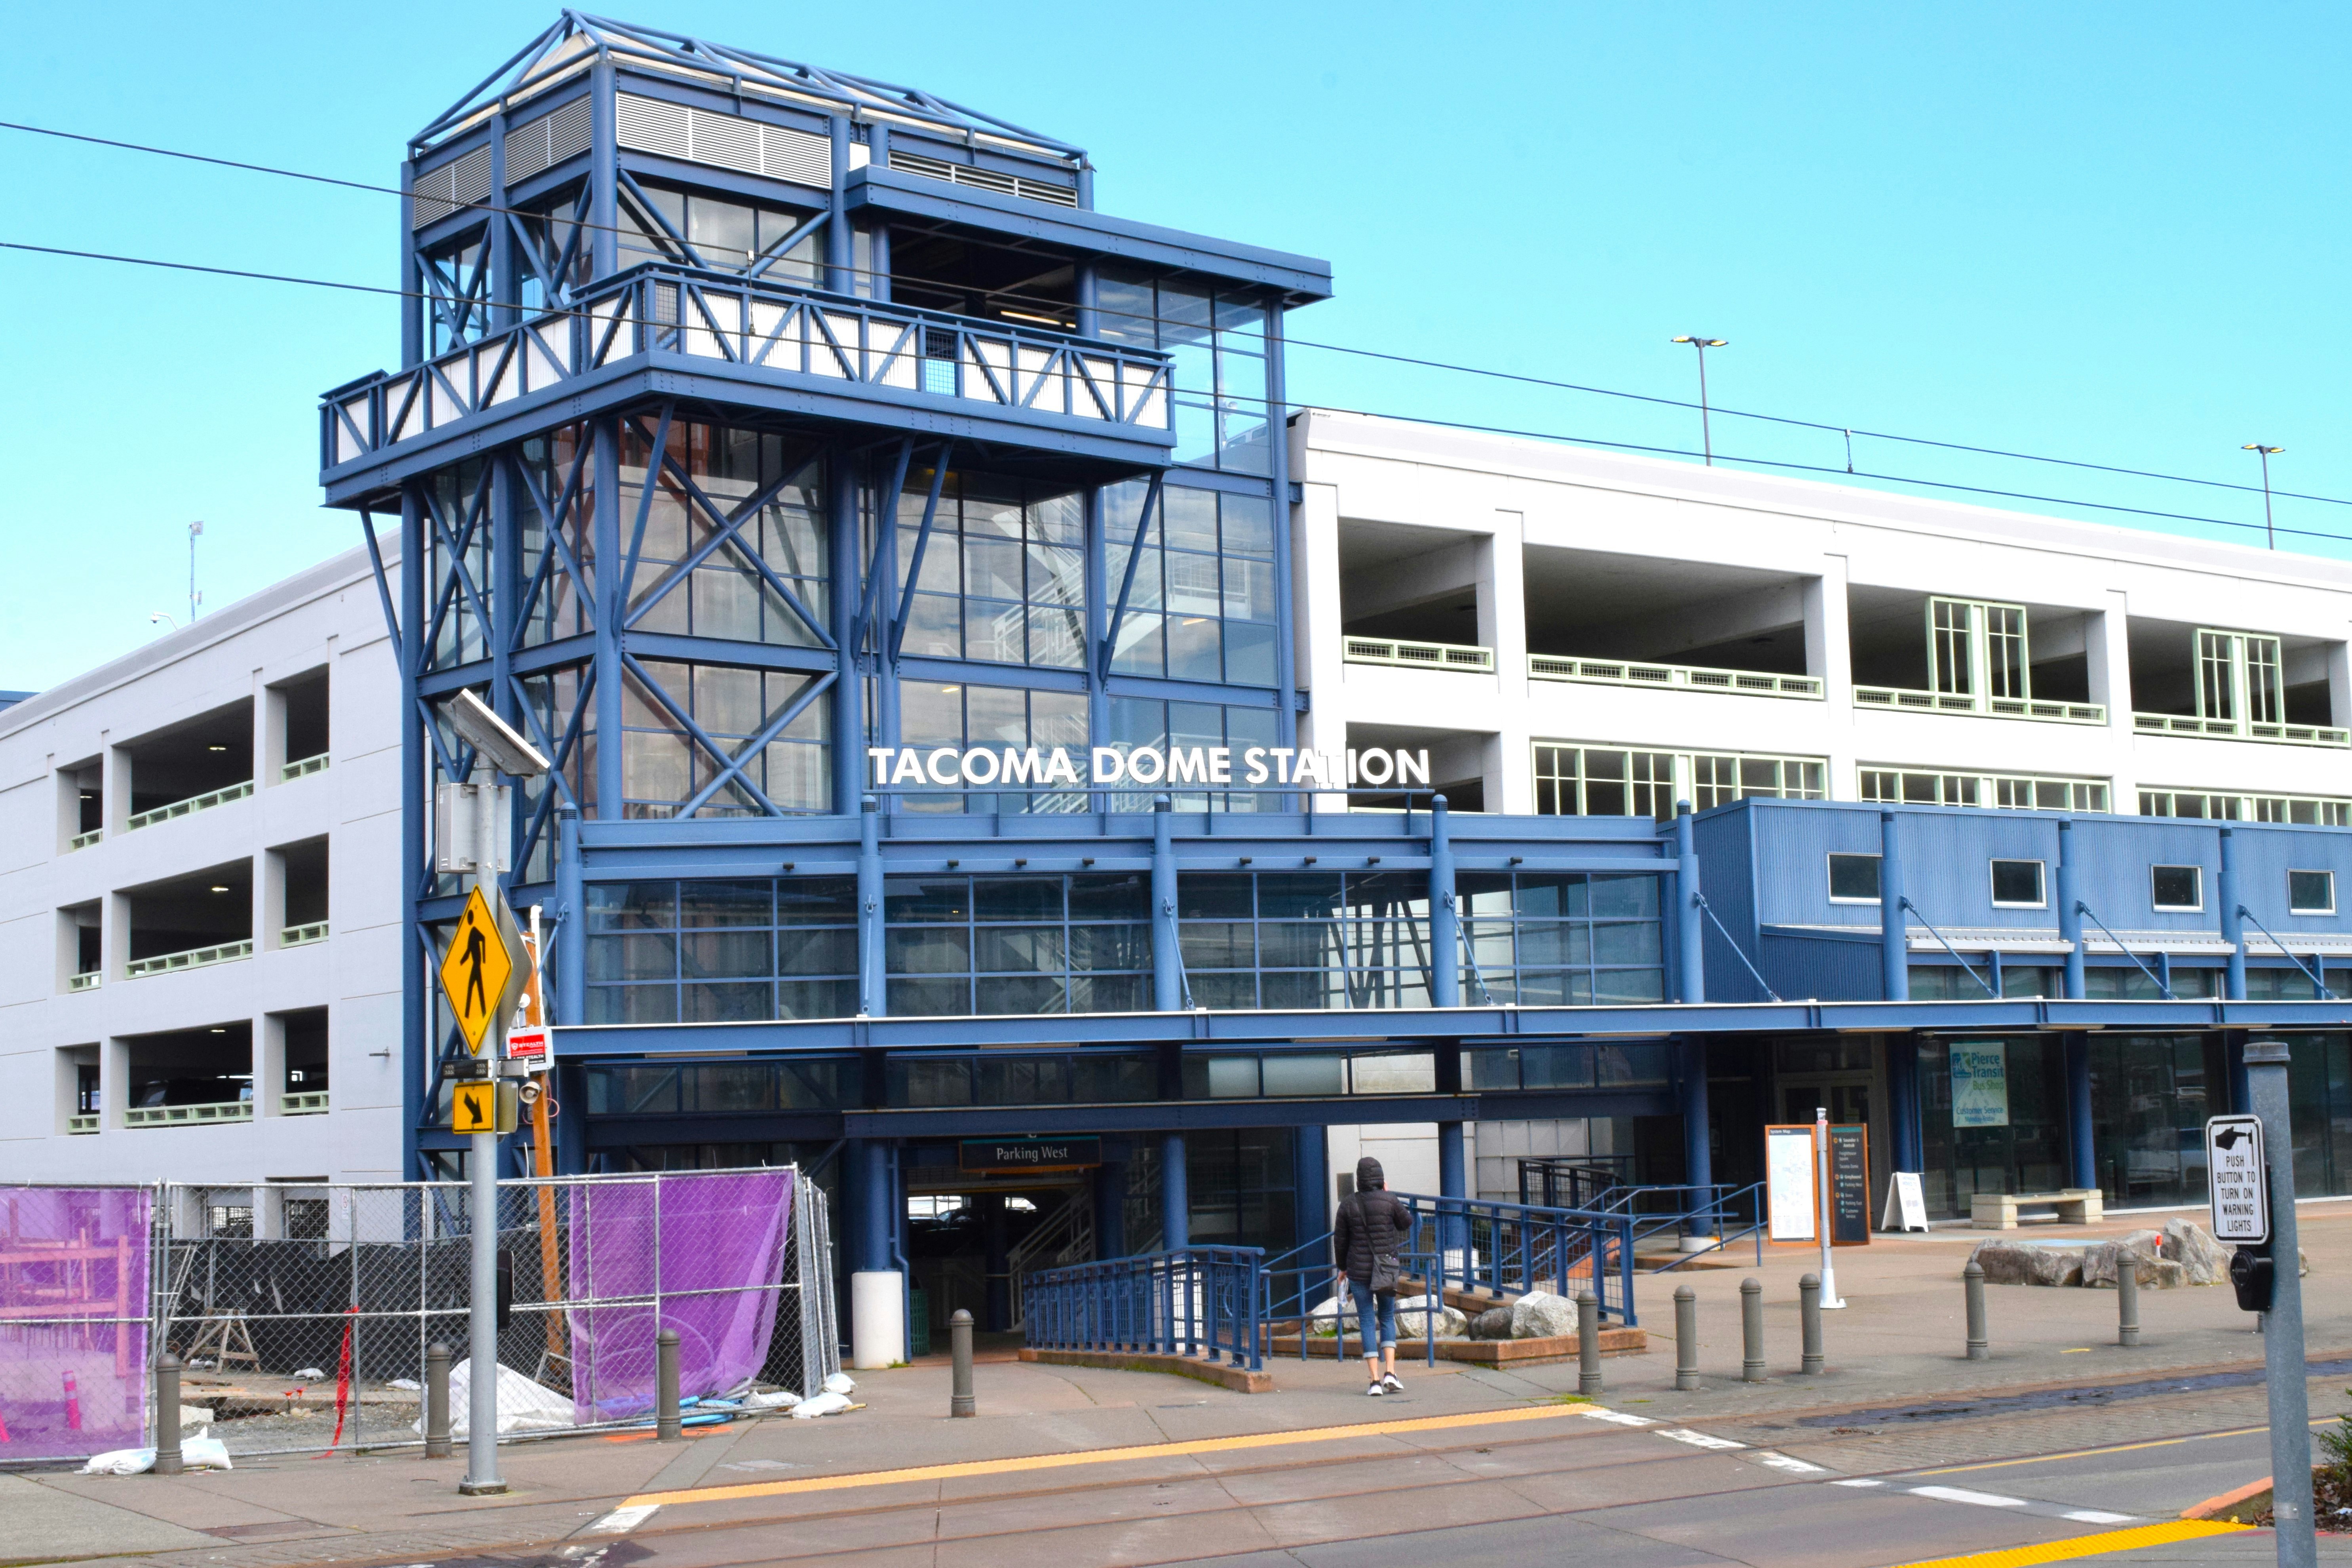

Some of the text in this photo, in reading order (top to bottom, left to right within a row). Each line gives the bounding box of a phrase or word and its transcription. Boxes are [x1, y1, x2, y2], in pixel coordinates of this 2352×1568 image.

[869, 747, 1430, 784] TACOMA DOME STATION
[1971, 1052, 2000, 1064] Pierce
[1972, 1066, 2004, 1077] Transit
[1973, 1080, 2004, 1092] Bus Shop
[997, 1146, 1068, 1162] Parking West
[2226, 1155, 2244, 1167] PUSH
[2217, 1171, 2255, 1184] BUTTON TO
[2221, 1187, 2253, 1199] TURN ON
[2223, 1204, 2253, 1215] WARNING
[2227, 1220, 2251, 1232] LIGHTS
